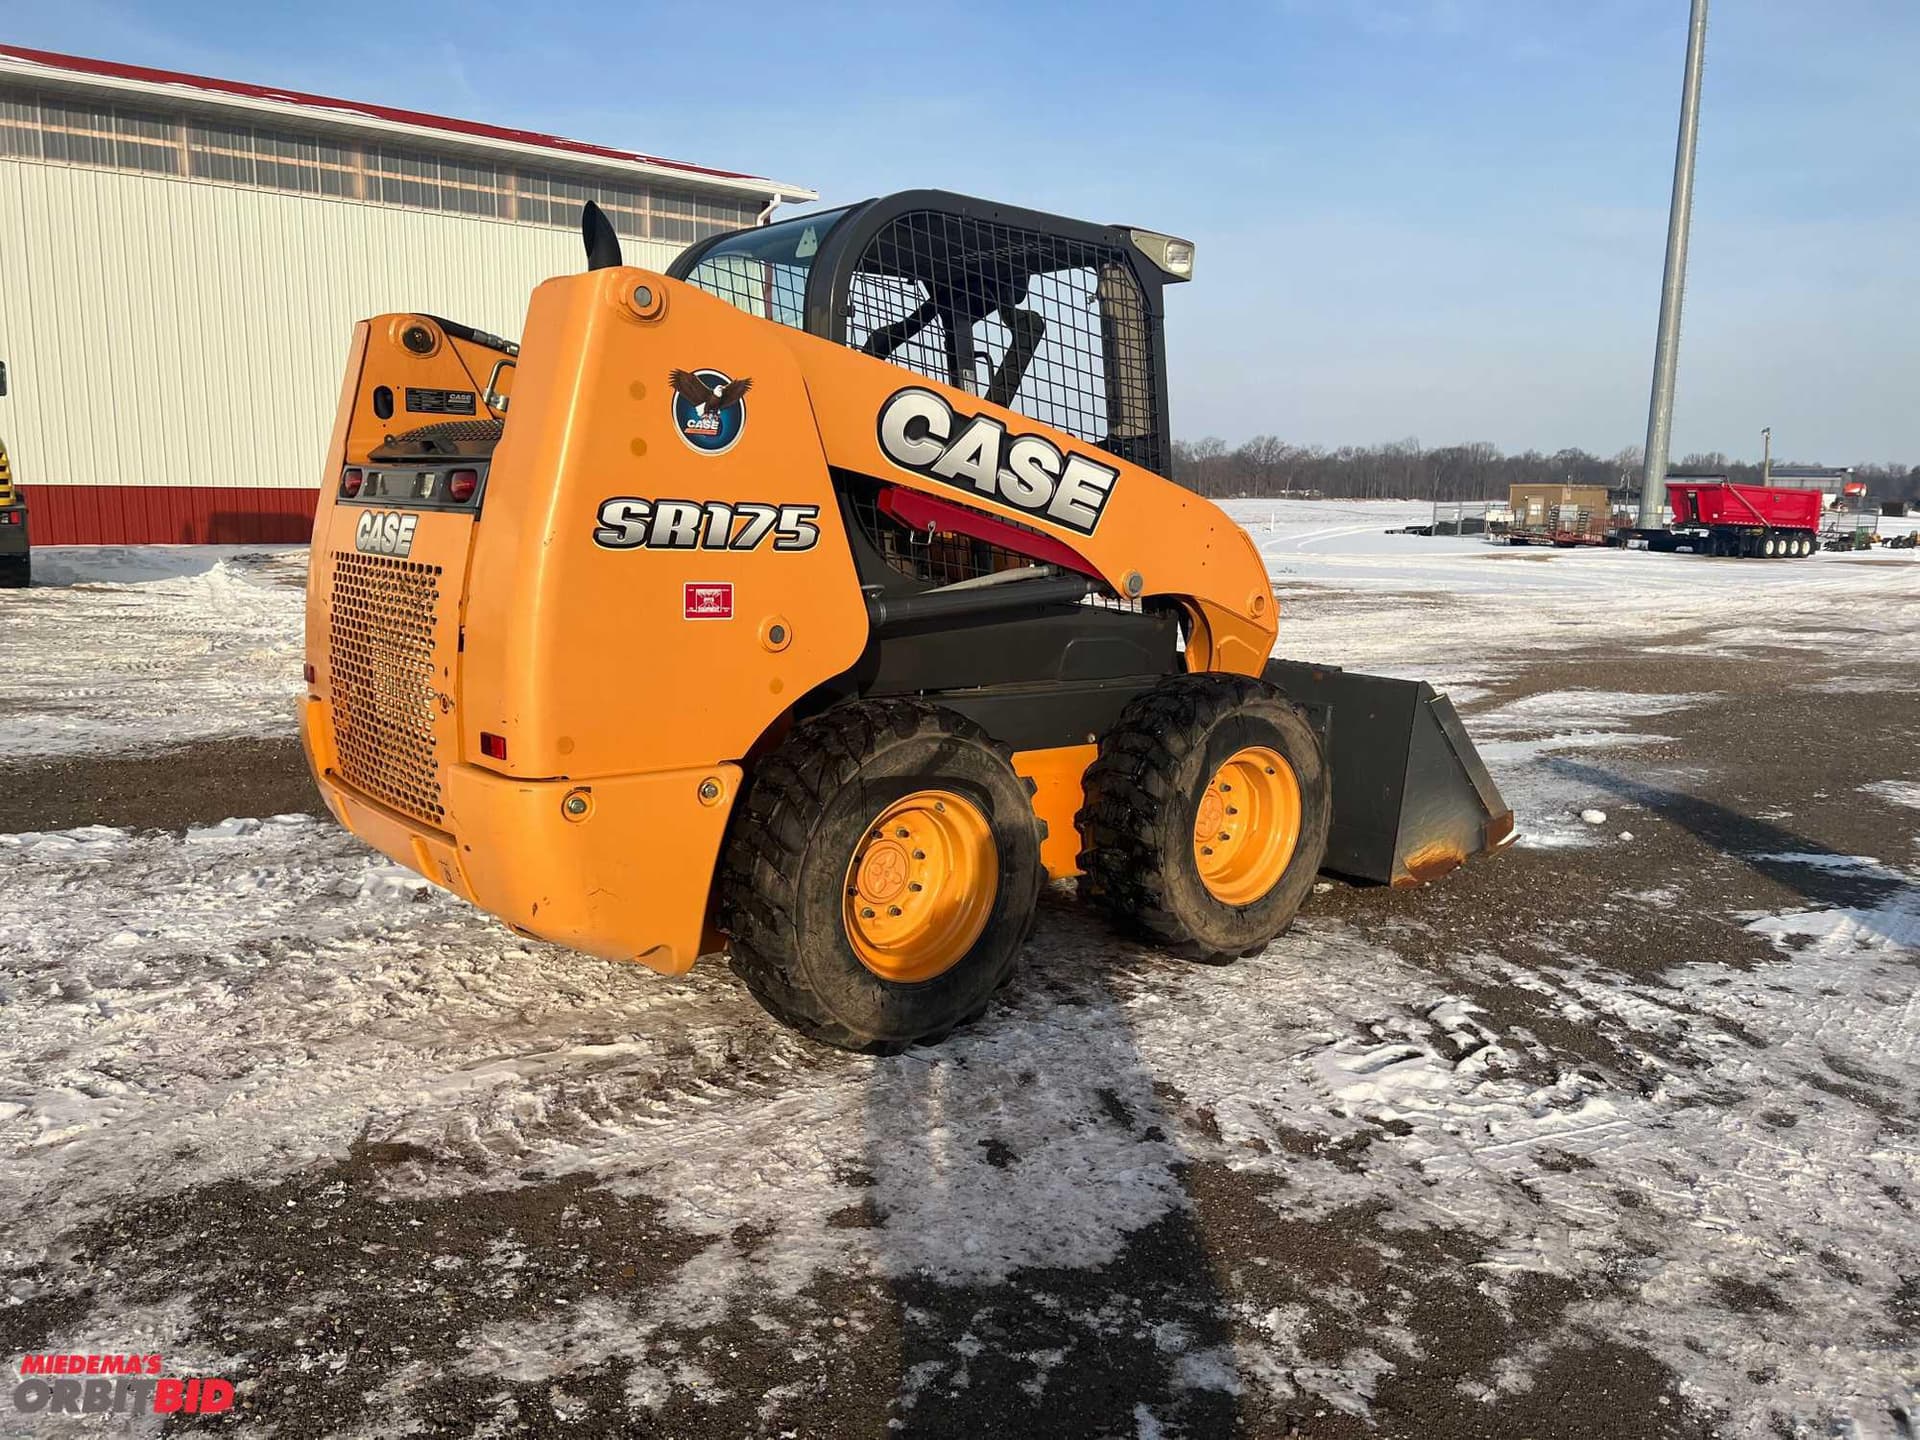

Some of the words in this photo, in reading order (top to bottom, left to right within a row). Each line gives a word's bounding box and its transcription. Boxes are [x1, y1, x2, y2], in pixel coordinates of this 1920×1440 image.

[686, 419, 720, 430] CASE
[879, 387, 1118, 534] CASE
[356, 510, 418, 557] CASE
[592, 496, 820, 551] SR175
